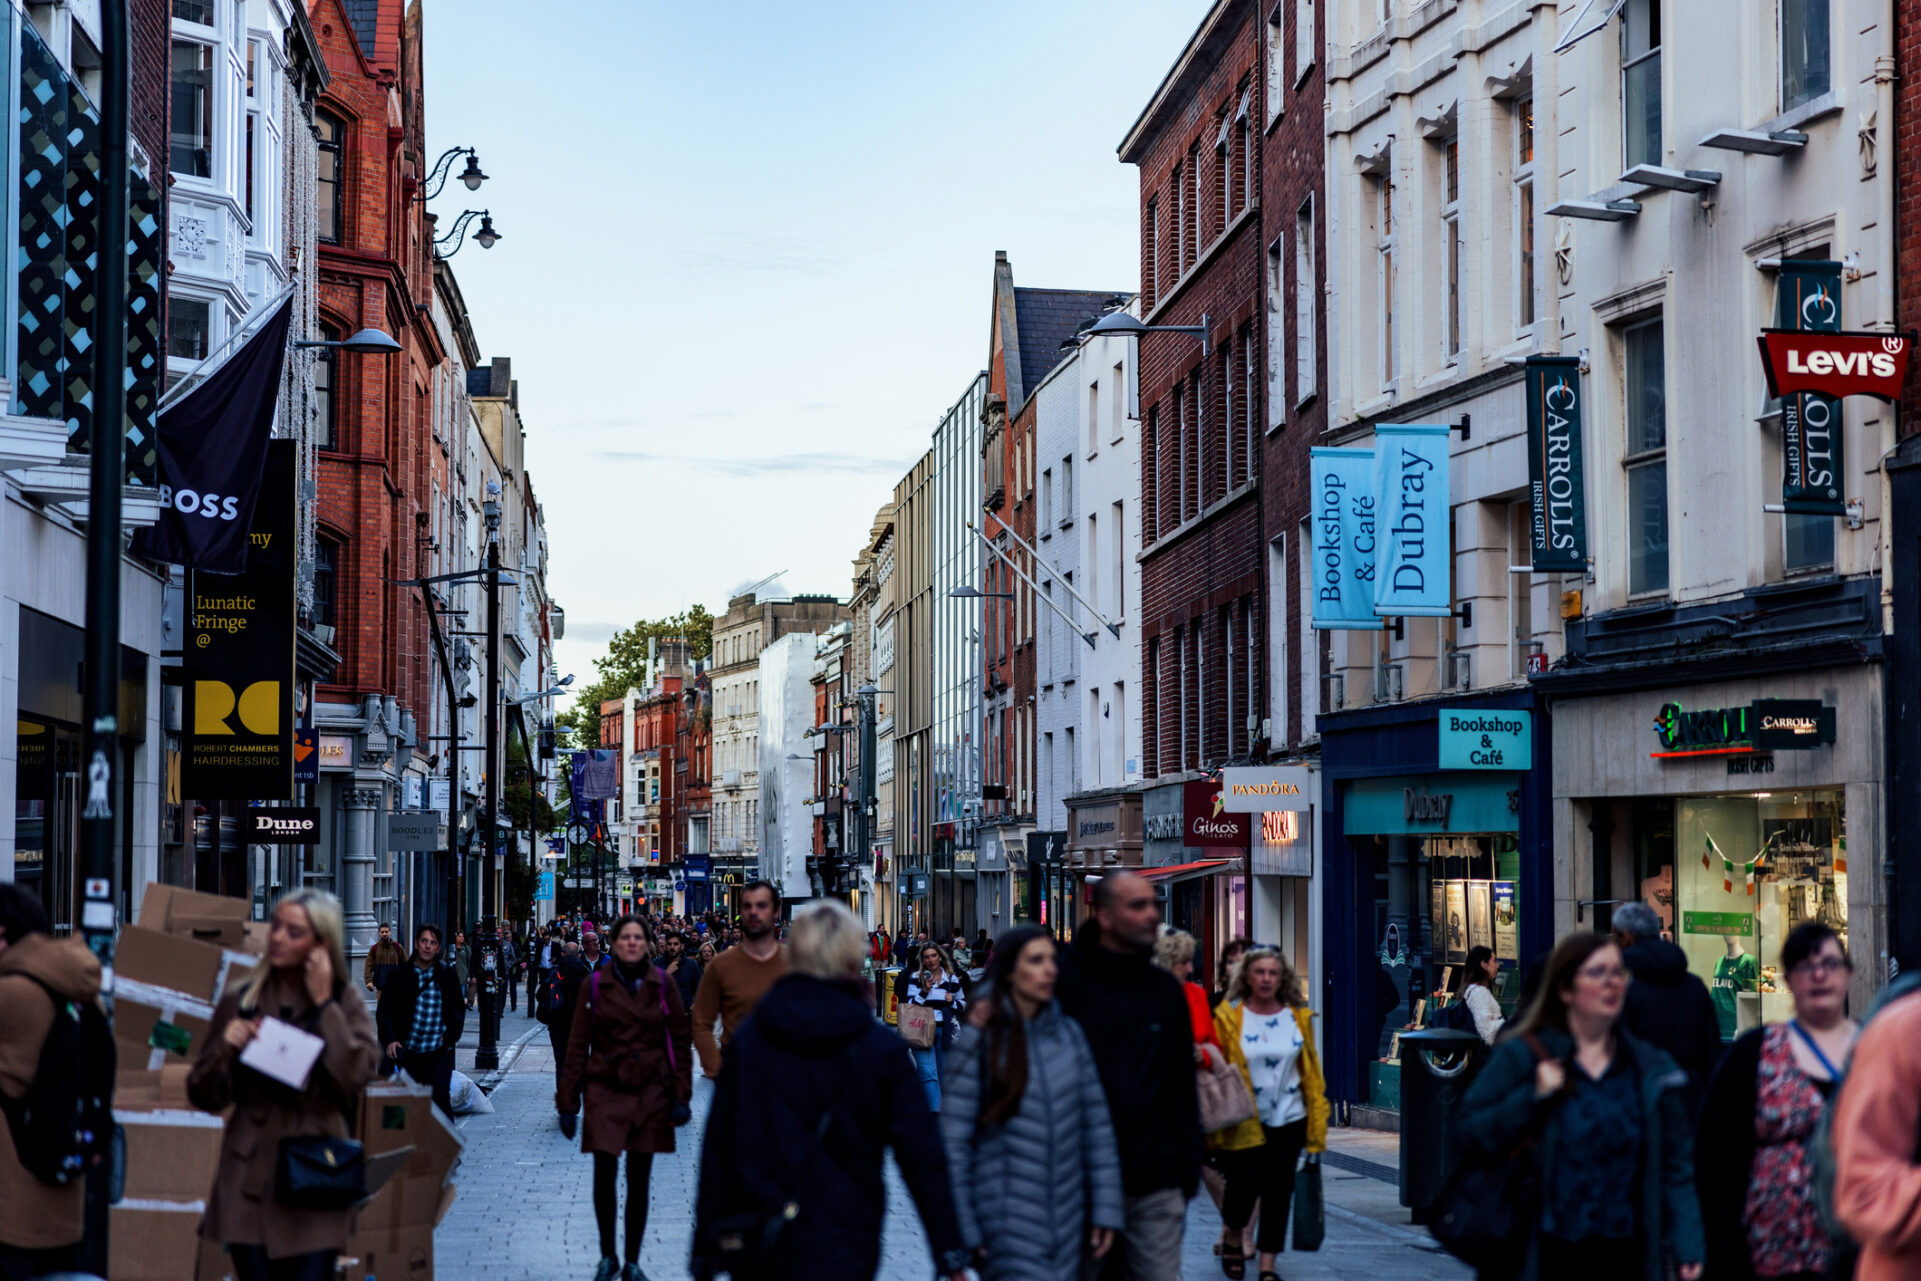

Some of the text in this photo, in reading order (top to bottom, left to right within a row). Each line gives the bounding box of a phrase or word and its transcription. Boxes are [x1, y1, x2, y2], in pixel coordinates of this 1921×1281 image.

[1786, 406, 1801, 486] IRISH GIFTS
[1546, 384, 1576, 549] CARROLLS
[159, 483, 239, 521] BOSS
[1352, 495, 1375, 554] Café
[1391, 448, 1434, 594] Dubray
[1533, 480, 1546, 549] IRISH GIFTS
[1318, 473, 1346, 603] Bookshop
[196, 595, 256, 610] Lunatic
[196, 614, 247, 634] Fringe
[196, 633, 211, 648] @
[1450, 716, 1523, 736] Bookshop
[1763, 716, 1816, 728] CARROLLS
[1481, 735, 1493, 748] &
[193, 756, 280, 766] HAIRDRESSING
[1470, 750, 1504, 765] Café
[1751, 756, 1774, 774] GIFTS
[1403, 786, 1453, 829] Dubray
[256, 816, 314, 830] Dune
[1193, 817, 1239, 835] Gino's
